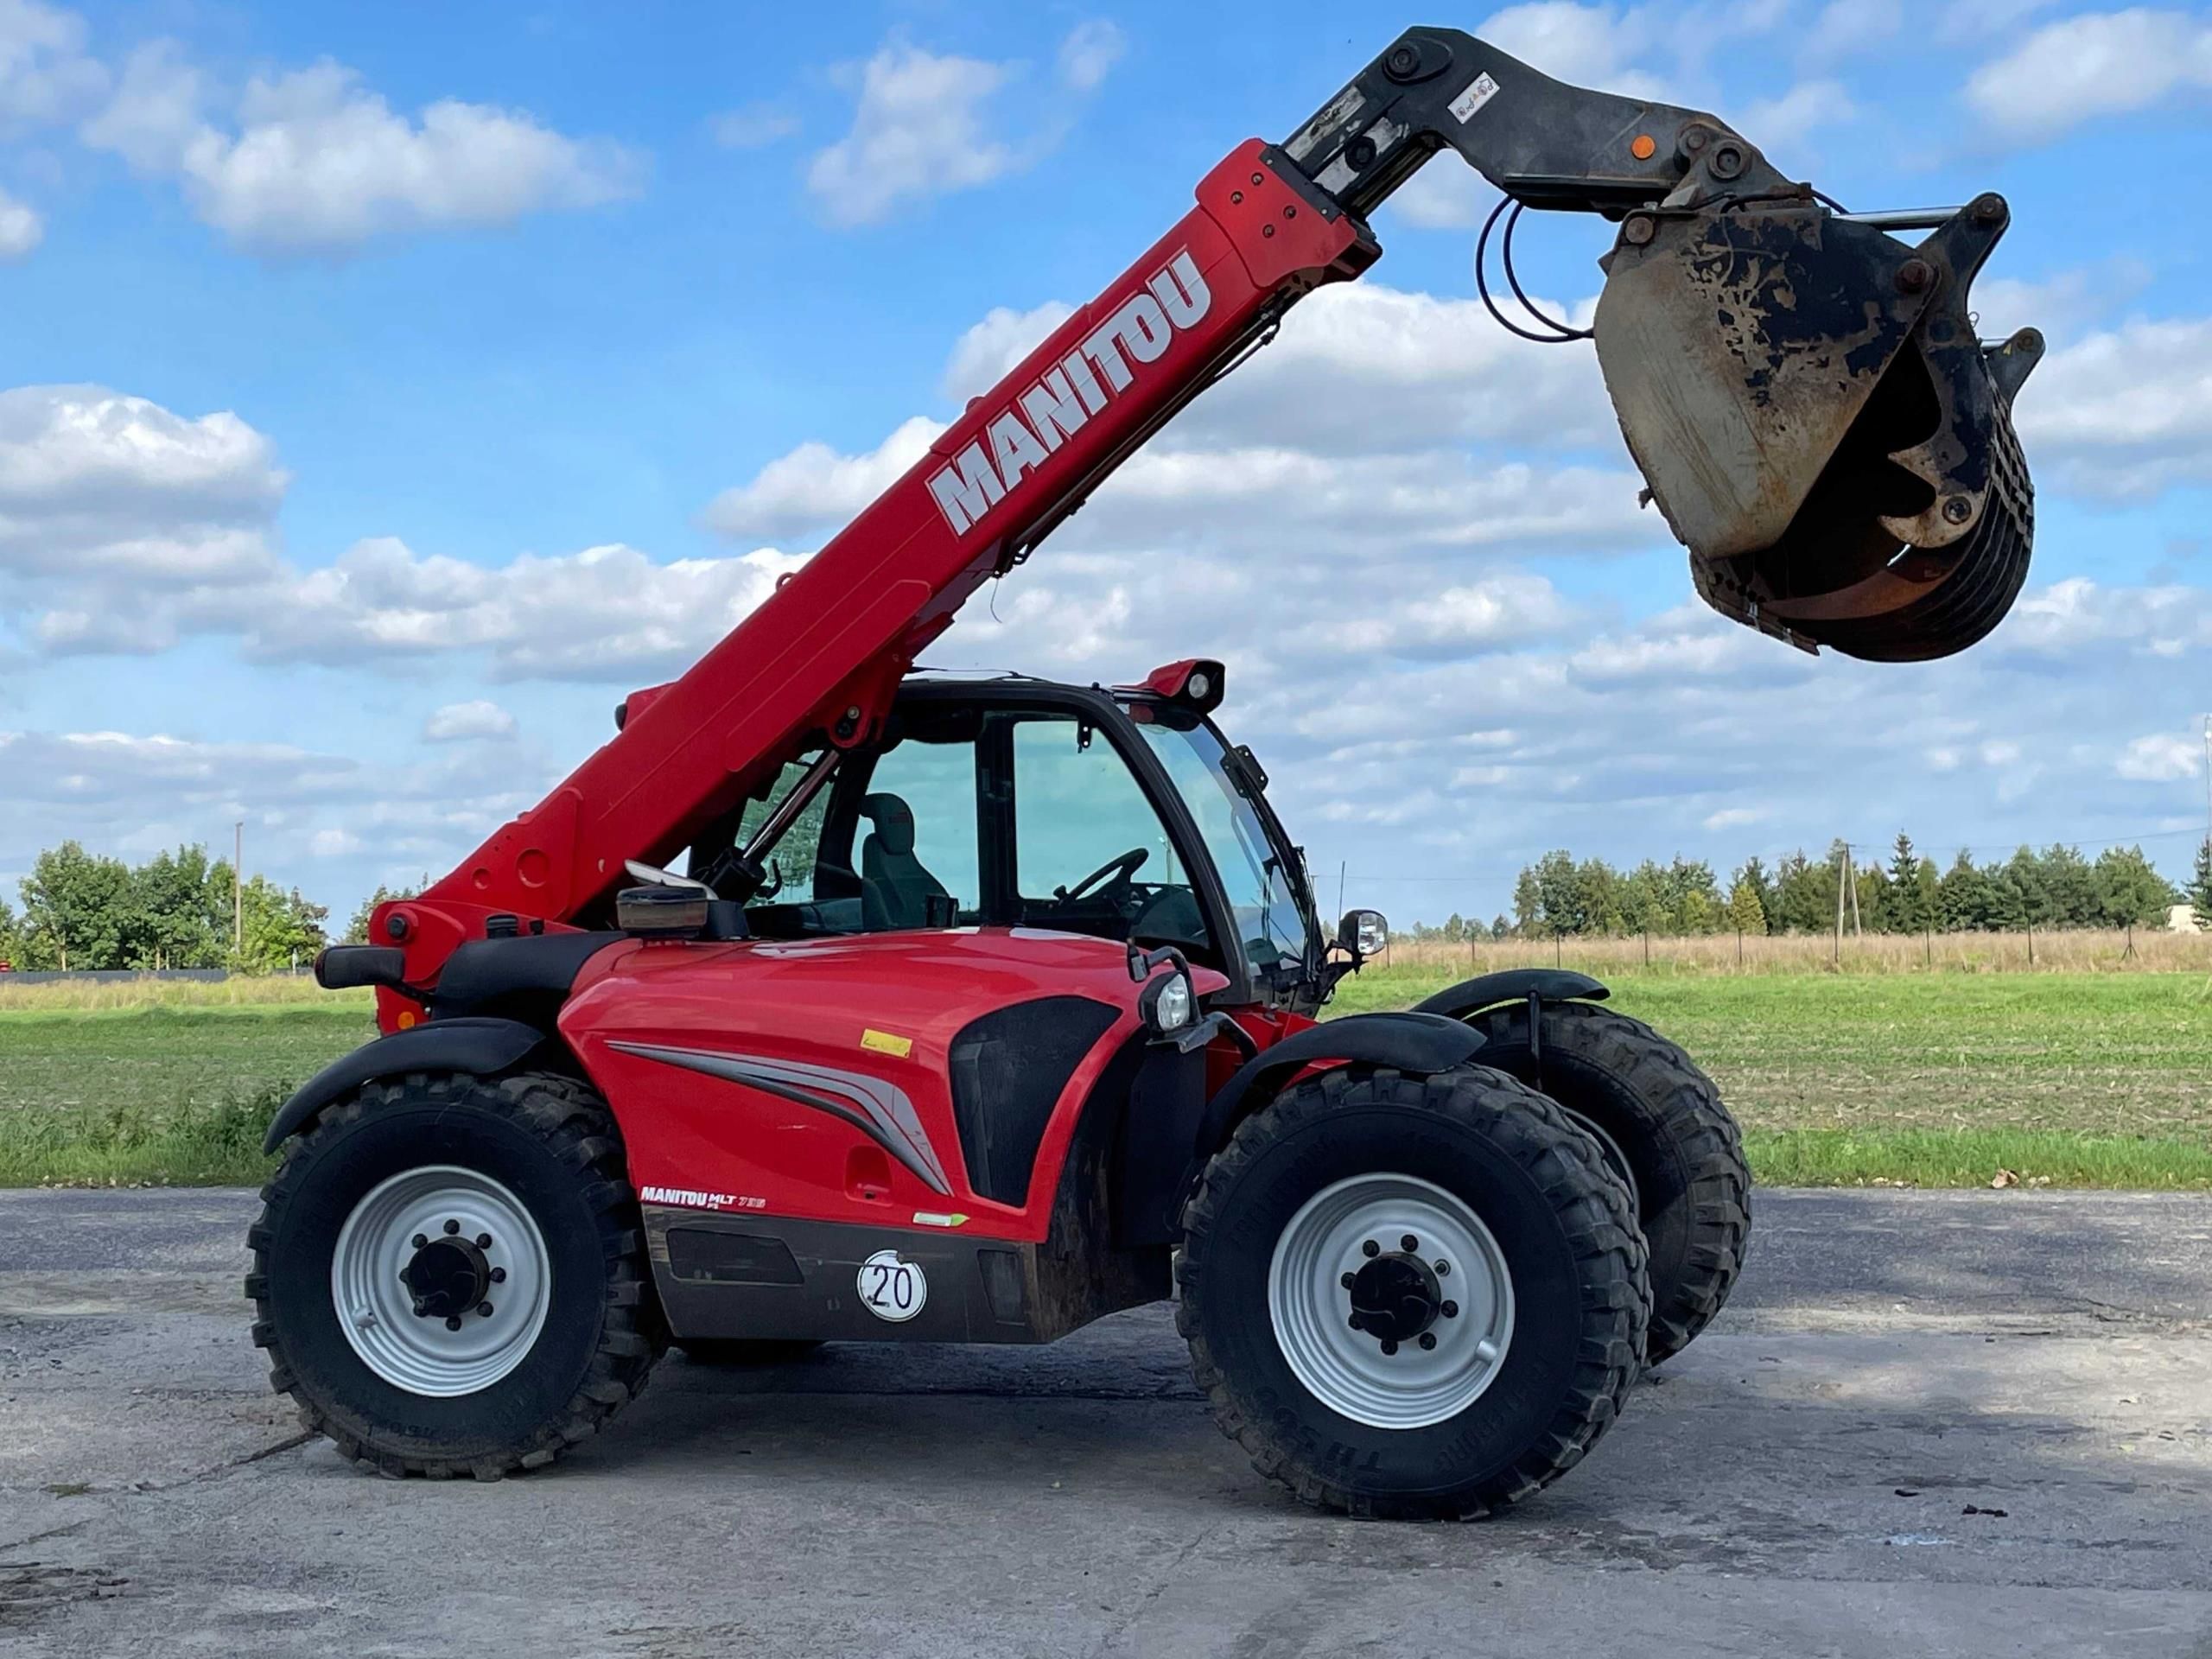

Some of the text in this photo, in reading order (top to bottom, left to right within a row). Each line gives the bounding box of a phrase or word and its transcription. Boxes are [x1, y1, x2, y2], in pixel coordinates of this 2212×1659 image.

[925, 246, 1211, 538] MANITOU
[640, 1186, 708, 1206] MANITOU
[709, 1193, 737, 1205] MLT
[873, 1264, 912, 1309] 20
